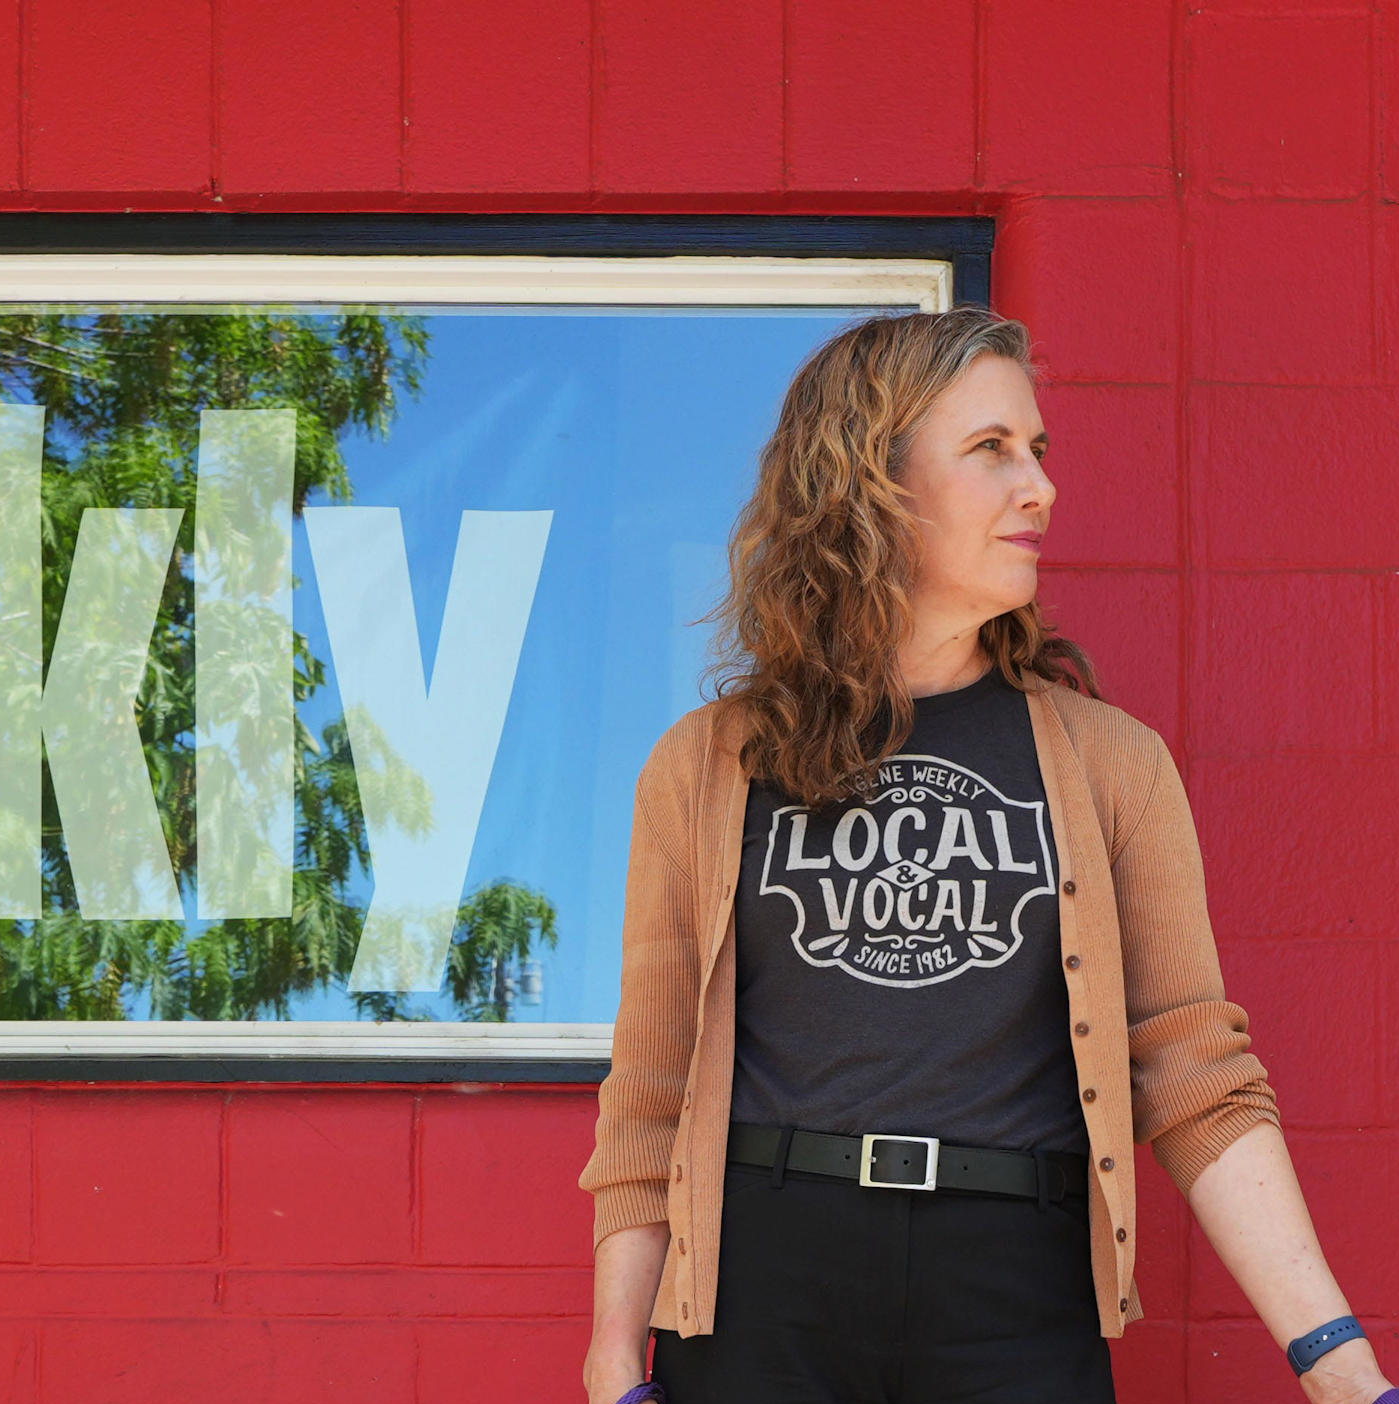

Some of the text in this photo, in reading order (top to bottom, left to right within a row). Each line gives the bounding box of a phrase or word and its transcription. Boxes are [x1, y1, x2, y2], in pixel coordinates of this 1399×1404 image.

[912, 765, 986, 801] WEEKLY
[785, 806, 1037, 874] LOCAL
[896, 864, 918, 883] &
[818, 877, 998, 932] VOCAL
[853, 944, 959, 975] SINCE 1982
